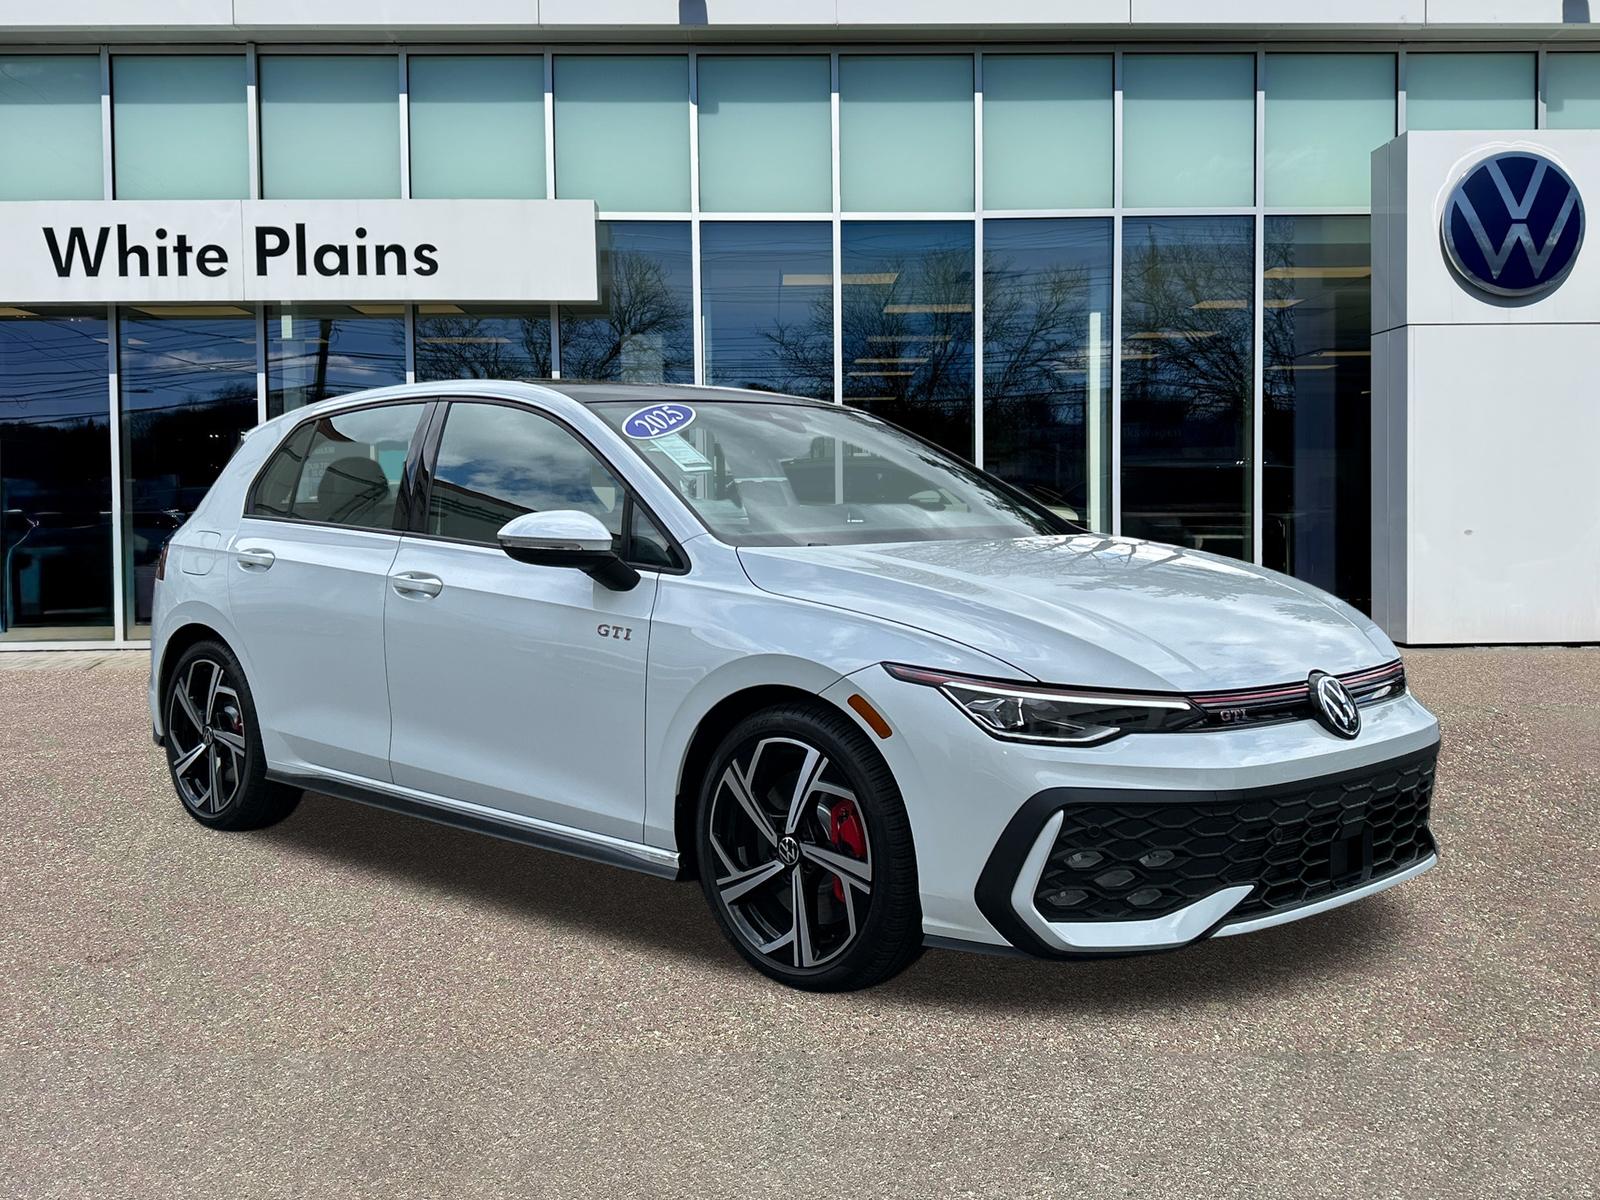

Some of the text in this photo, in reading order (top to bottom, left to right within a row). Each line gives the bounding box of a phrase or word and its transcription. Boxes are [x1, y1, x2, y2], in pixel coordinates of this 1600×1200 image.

[1448, 153, 1580, 281] VW
[42, 222, 440, 278] White Plains
[634, 405, 684, 436] 2025
[597, 624, 632, 641] GTI
[1220, 708, 1248, 721] GTI
